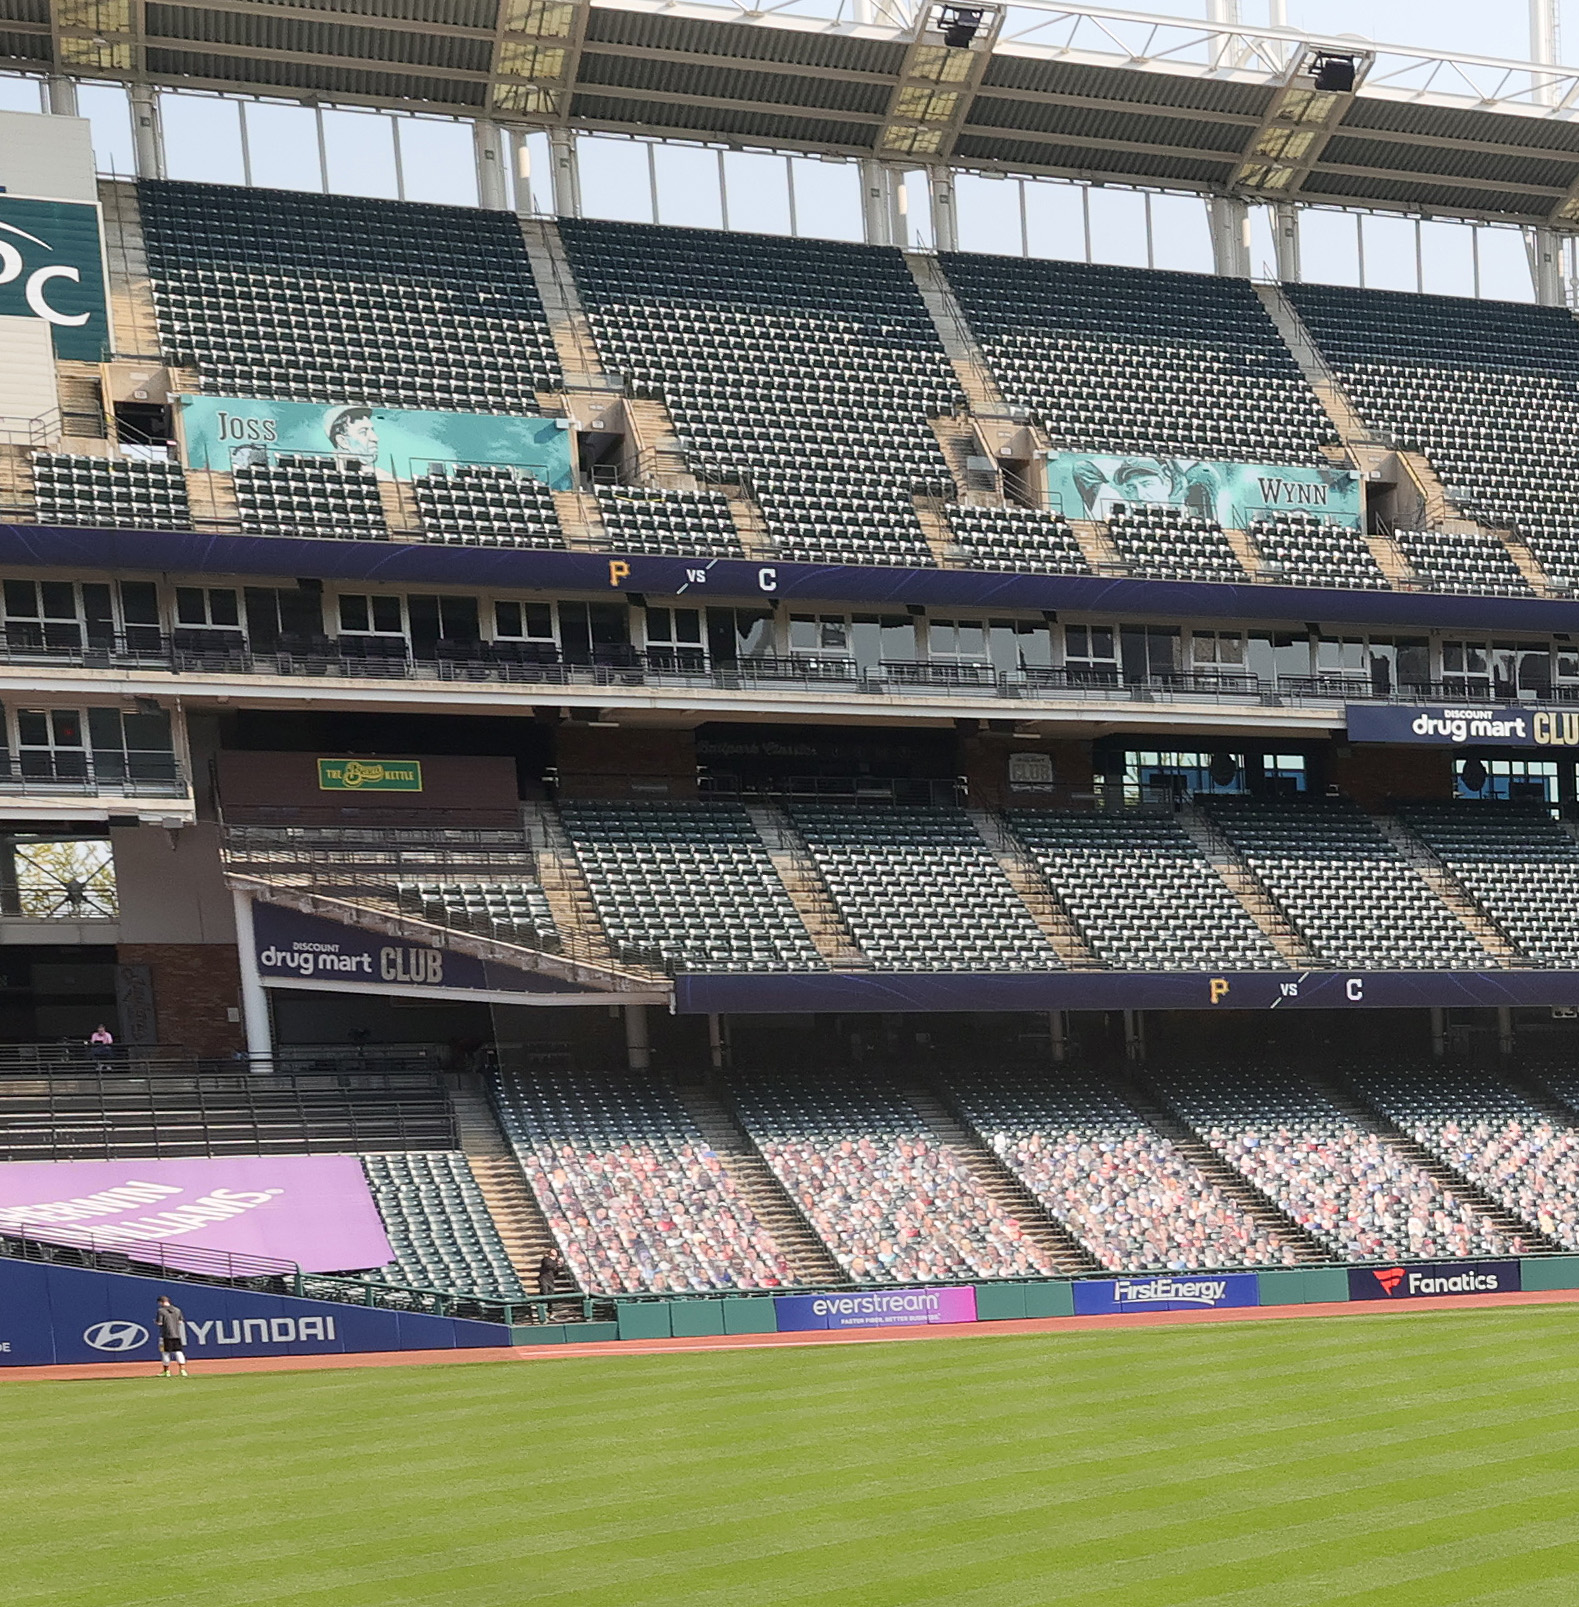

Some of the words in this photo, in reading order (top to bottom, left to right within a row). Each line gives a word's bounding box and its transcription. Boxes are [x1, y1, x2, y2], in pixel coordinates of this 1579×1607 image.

[609, 560, 630, 587] P
[759, 567, 777, 592] C
[1444, 709, 1493, 720] DISCOUNT
[1412, 713, 1467, 743] drug
[1470, 716, 1526, 739] mart
[293, 942, 340, 954] DISCOUNT
[261, 946, 314, 975] drug
[318, 952, 373, 973] mart
[380, 946, 443, 984] CLUB
[1209, 978, 1229, 1004] P
[1346, 978, 1364, 1001] C
[1113, 1279, 1226, 1303] FirstEnergy
[1408, 1271, 1498, 1295] Fanatics
[813, 1293, 938, 1316] everstream
